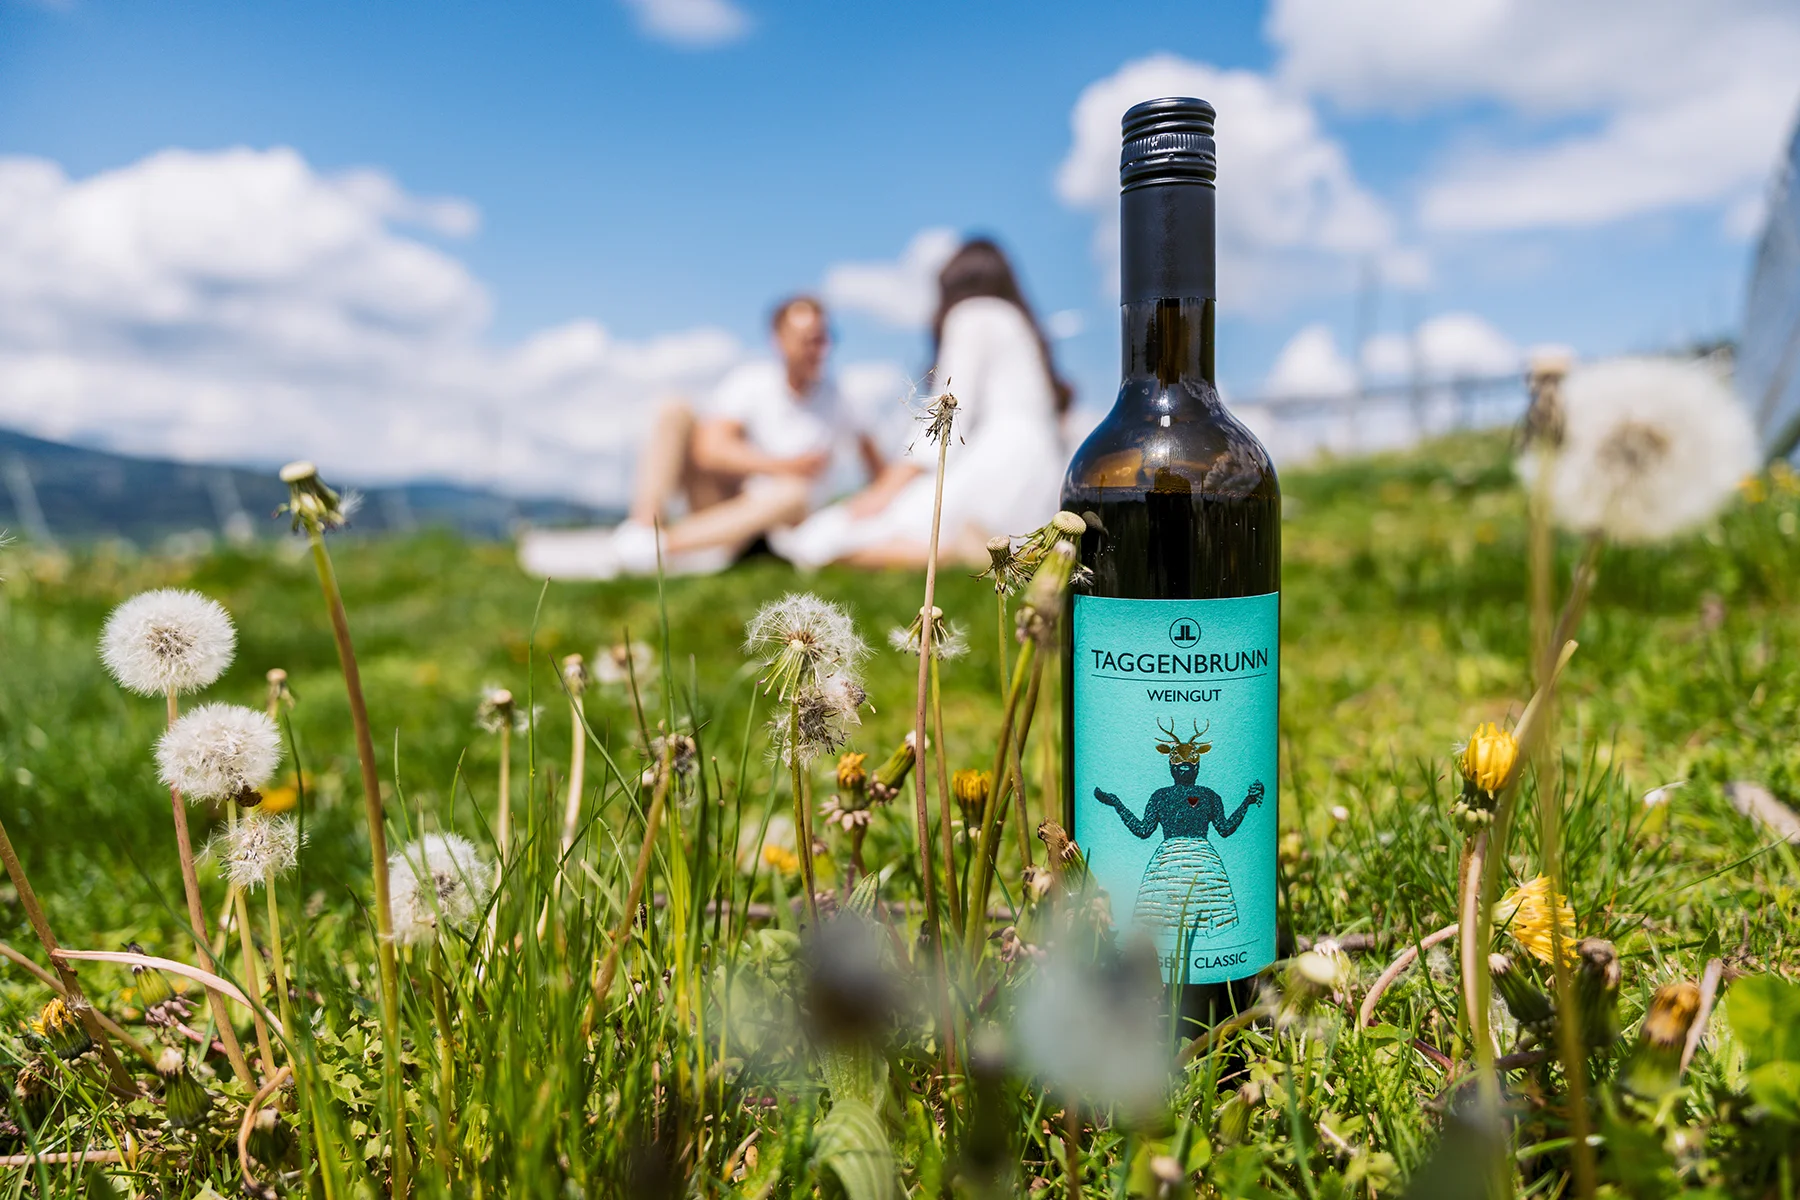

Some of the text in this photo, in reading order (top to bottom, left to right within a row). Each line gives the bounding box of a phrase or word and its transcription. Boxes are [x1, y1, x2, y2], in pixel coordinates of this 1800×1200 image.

[1091, 648, 1268, 674] TAGGENBRUNN
[1147, 689, 1222, 702] WEINGUT
[1194, 951, 1248, 969] CLASSIC
